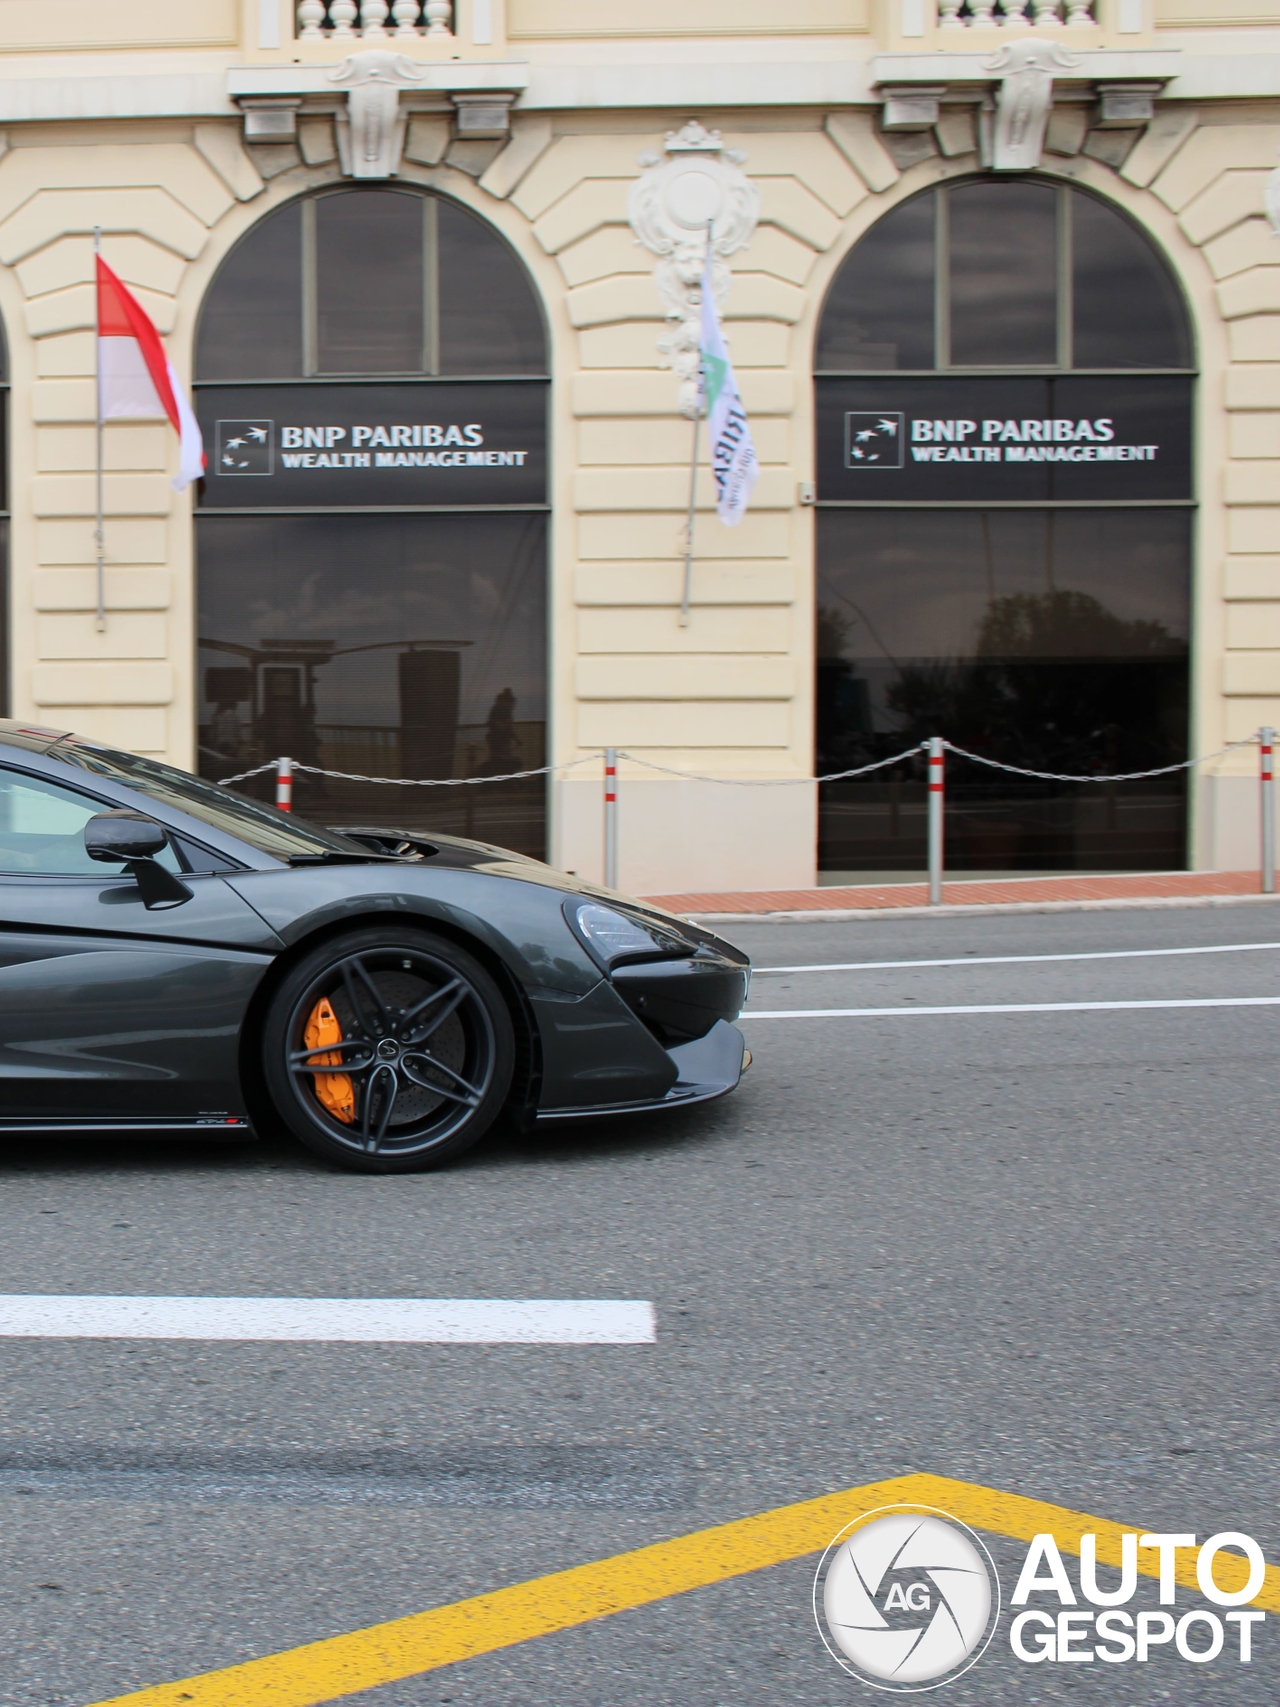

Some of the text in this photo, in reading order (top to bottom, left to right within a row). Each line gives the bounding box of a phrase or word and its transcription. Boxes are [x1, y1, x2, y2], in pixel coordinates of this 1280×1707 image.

[281, 423, 484, 449] BNP PARIBAS
[911, 418, 1115, 442] BNP PARIBAS
[281, 450, 528, 469] WEALTH MANAGEMENT
[911, 445, 1159, 462] WEALTH MANAGEMENT
